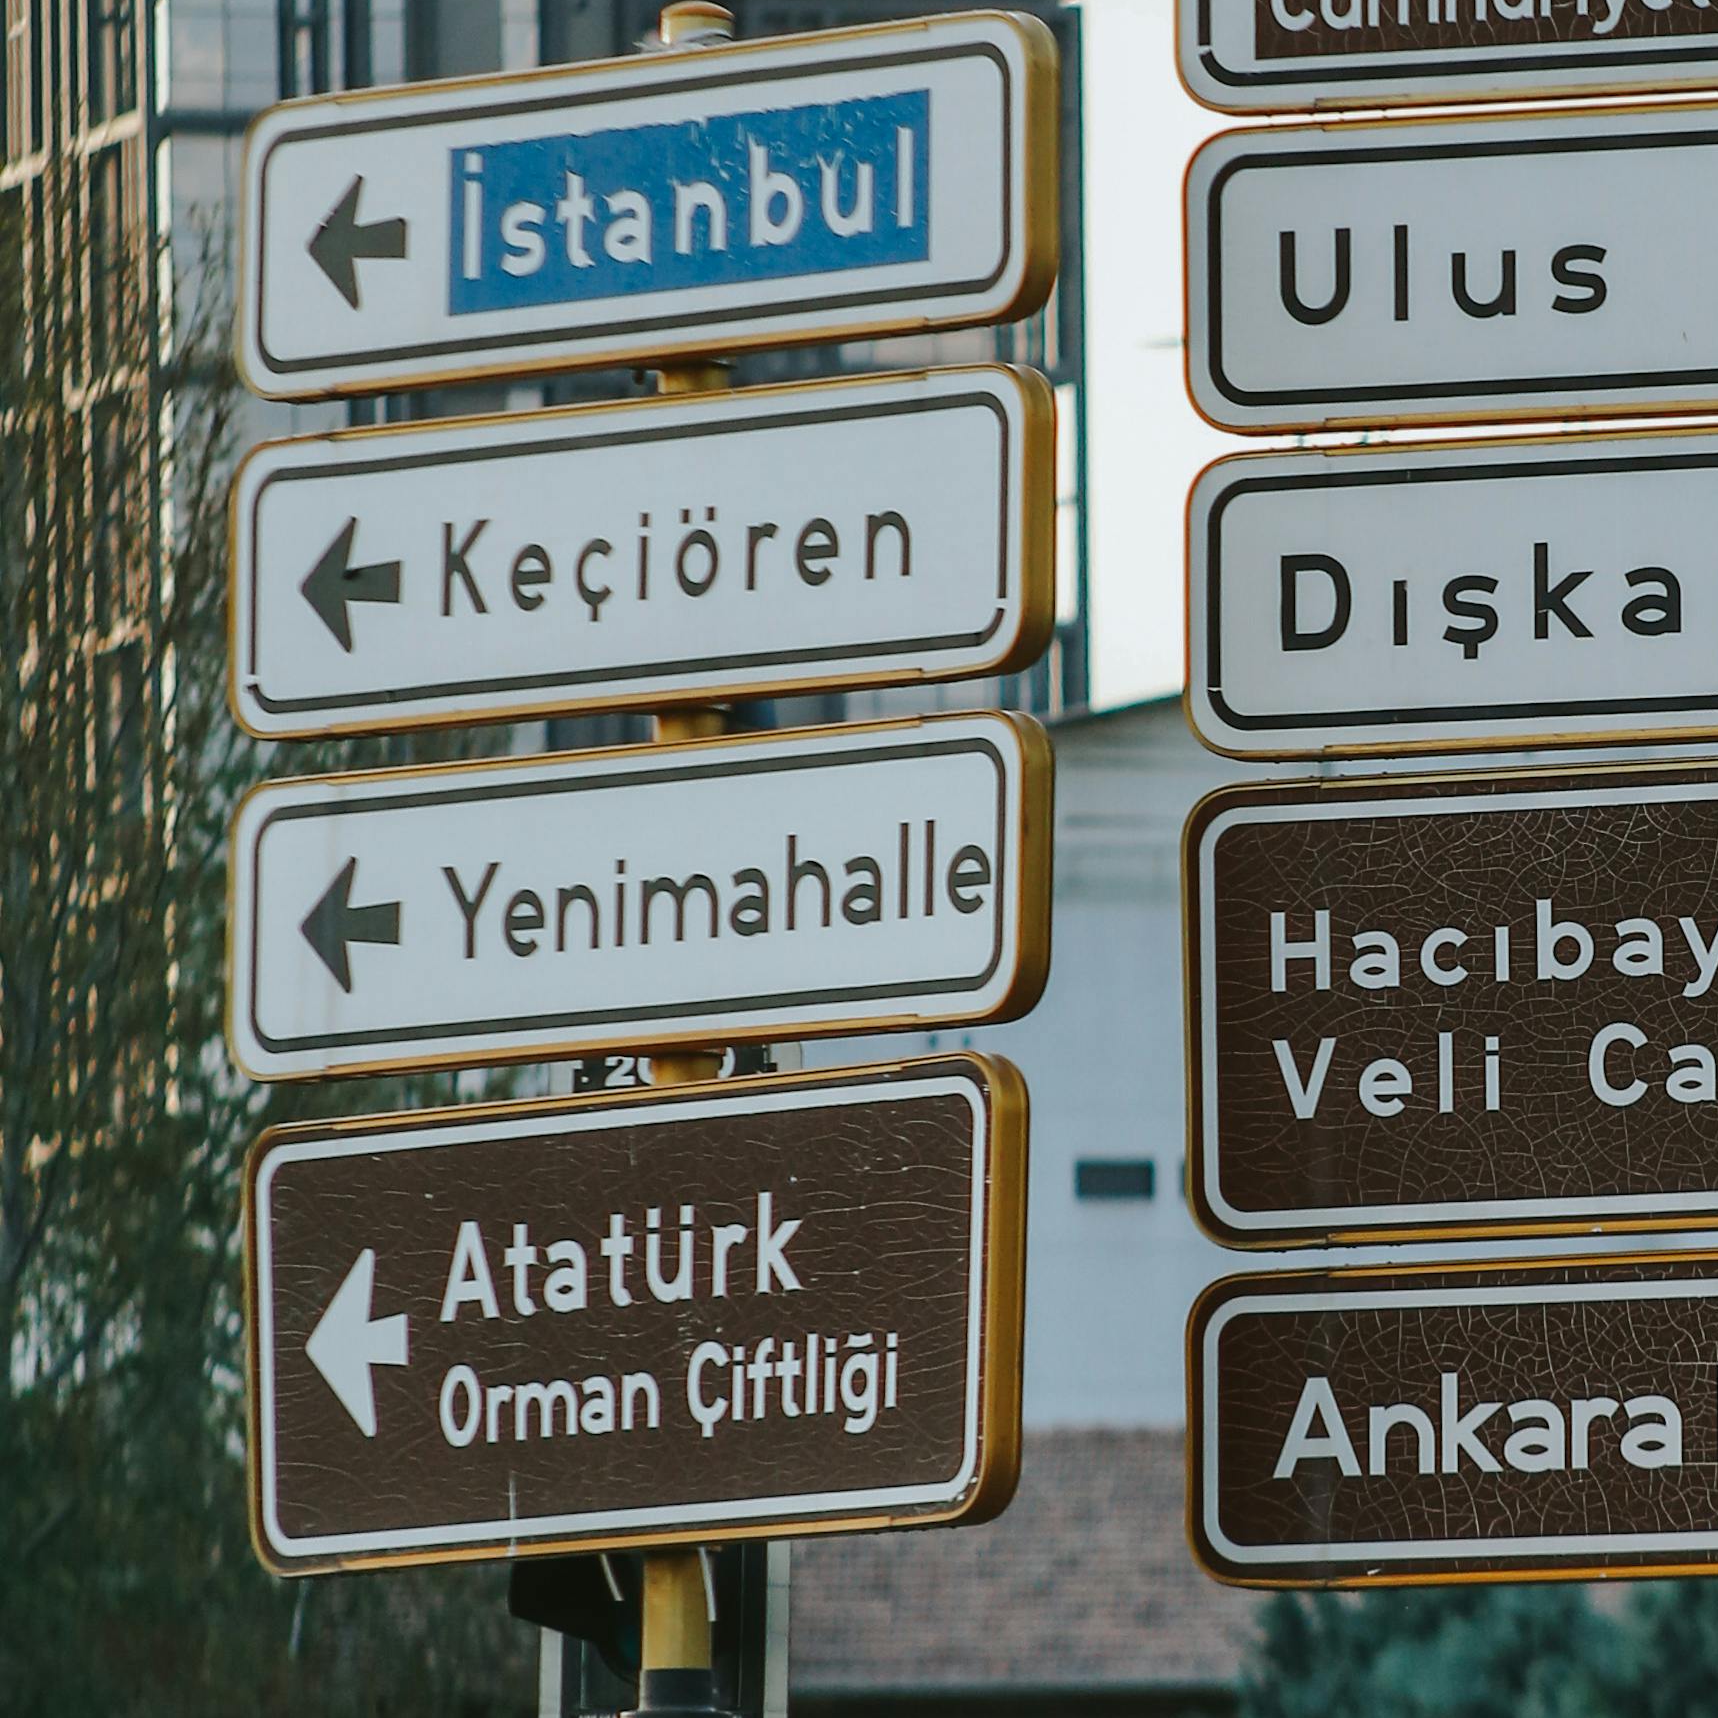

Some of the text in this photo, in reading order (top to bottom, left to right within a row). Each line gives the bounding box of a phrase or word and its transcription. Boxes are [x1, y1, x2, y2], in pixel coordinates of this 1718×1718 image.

[462, 126, 916, 281] İstanbul
[1278, 224, 1608, 326] Ulus
[440, 506, 913, 622] Keçiören
[440, 819, 993, 960] Yenimahalle
[1273, 1030, 1501, 1121] Veli
[440, 1191, 804, 1324] Atatürk
[439, 1331, 901, 1449] Orman Çiftliği
[1273, 1371, 1684, 1480] Ankara
